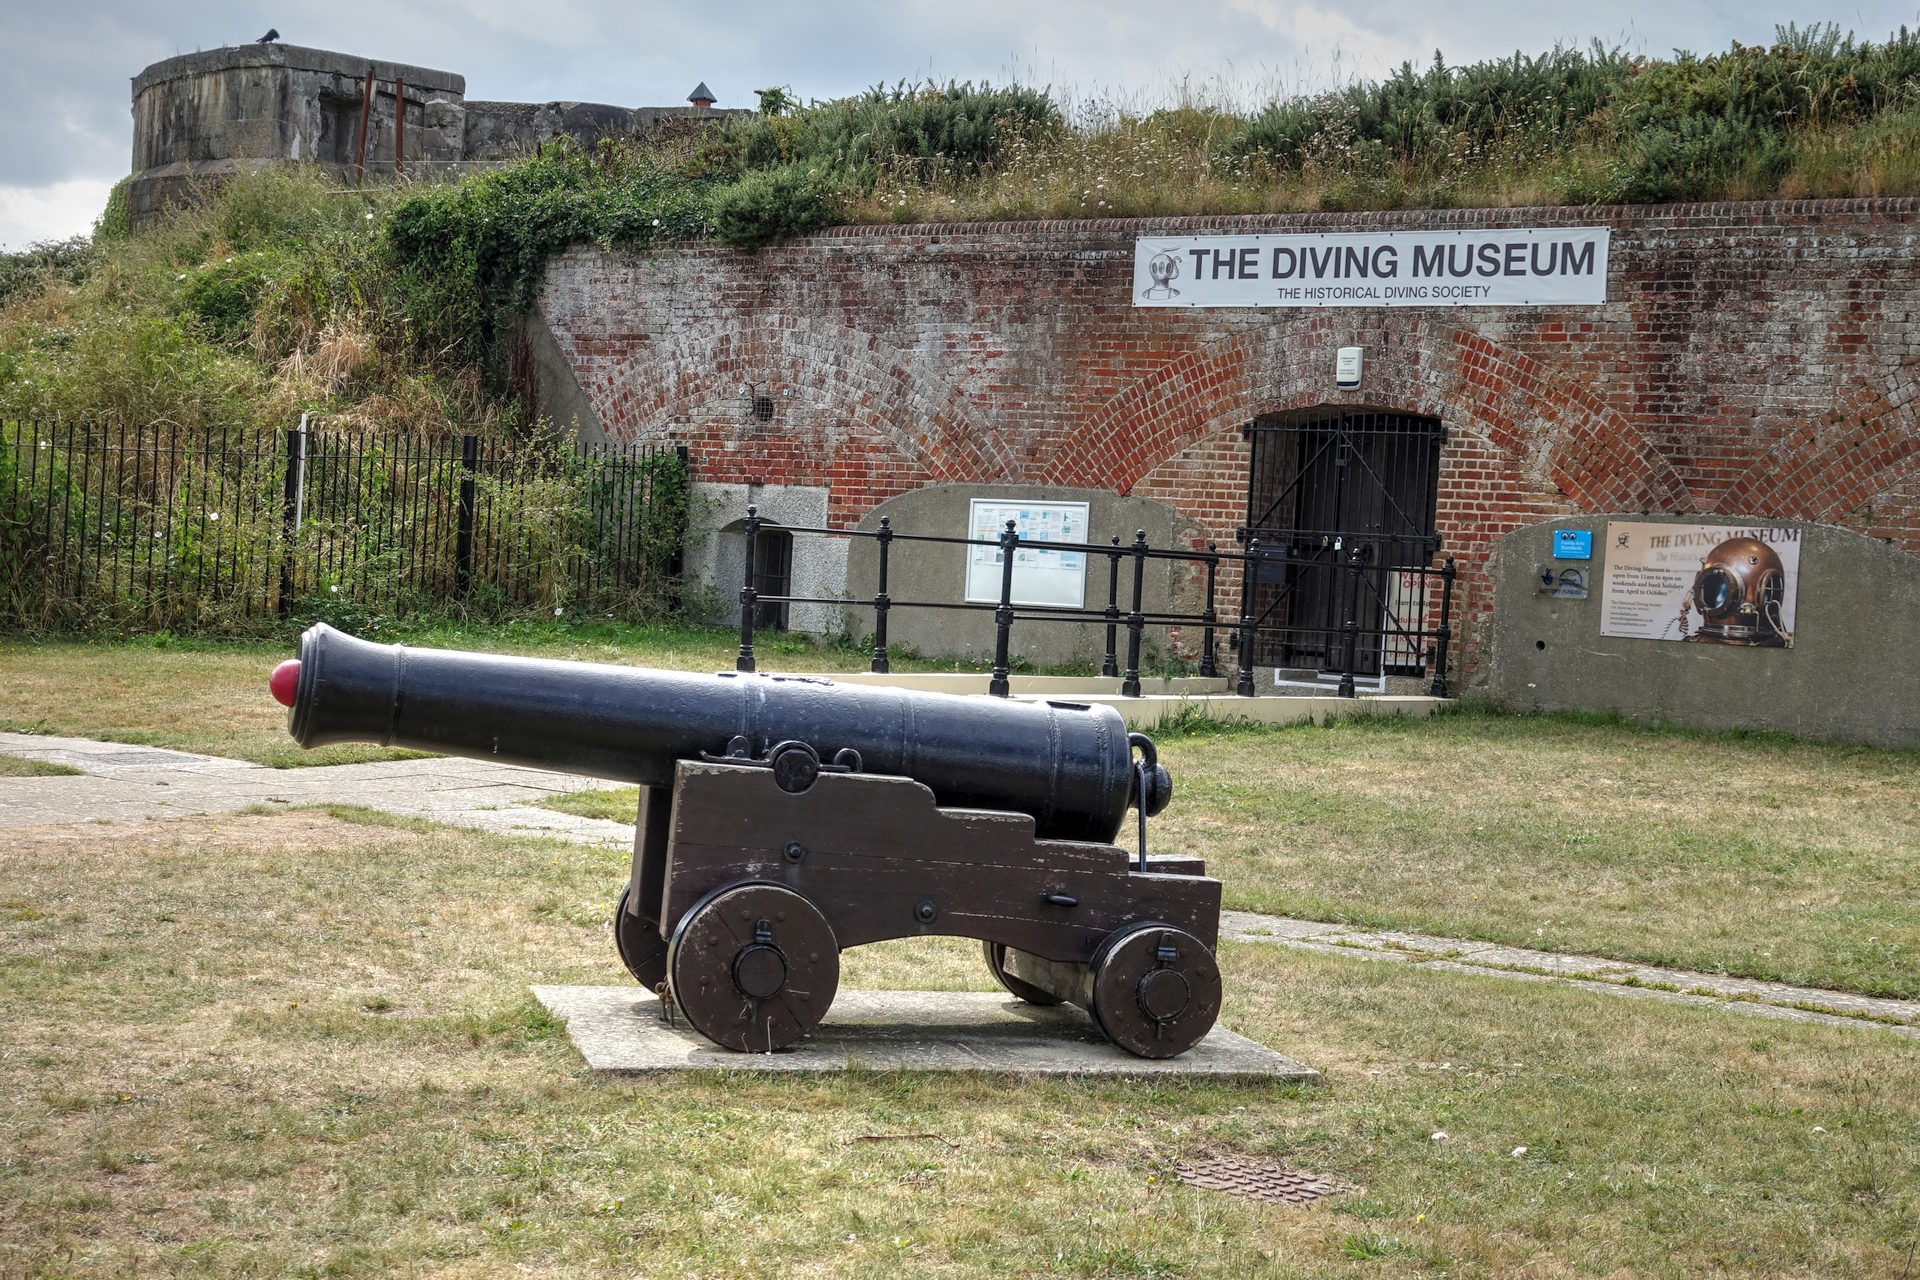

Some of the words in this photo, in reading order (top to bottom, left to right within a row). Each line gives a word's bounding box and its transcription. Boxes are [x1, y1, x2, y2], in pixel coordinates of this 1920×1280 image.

[1189, 248, 1260, 280] THE
[1272, 245, 1398, 280] DIVING
[1412, 242, 1595, 277] MUSEUM
[1278, 288, 1301, 299] THE
[1304, 287, 1380, 299] HISTORICAL
[1384, 286, 1428, 298] DIVING
[1432, 286, 1490, 298] SOCIETY
[1650, 536, 1672, 548] THE
[1674, 531, 1721, 547] DIVING
[1656, 551, 1668, 562] The
